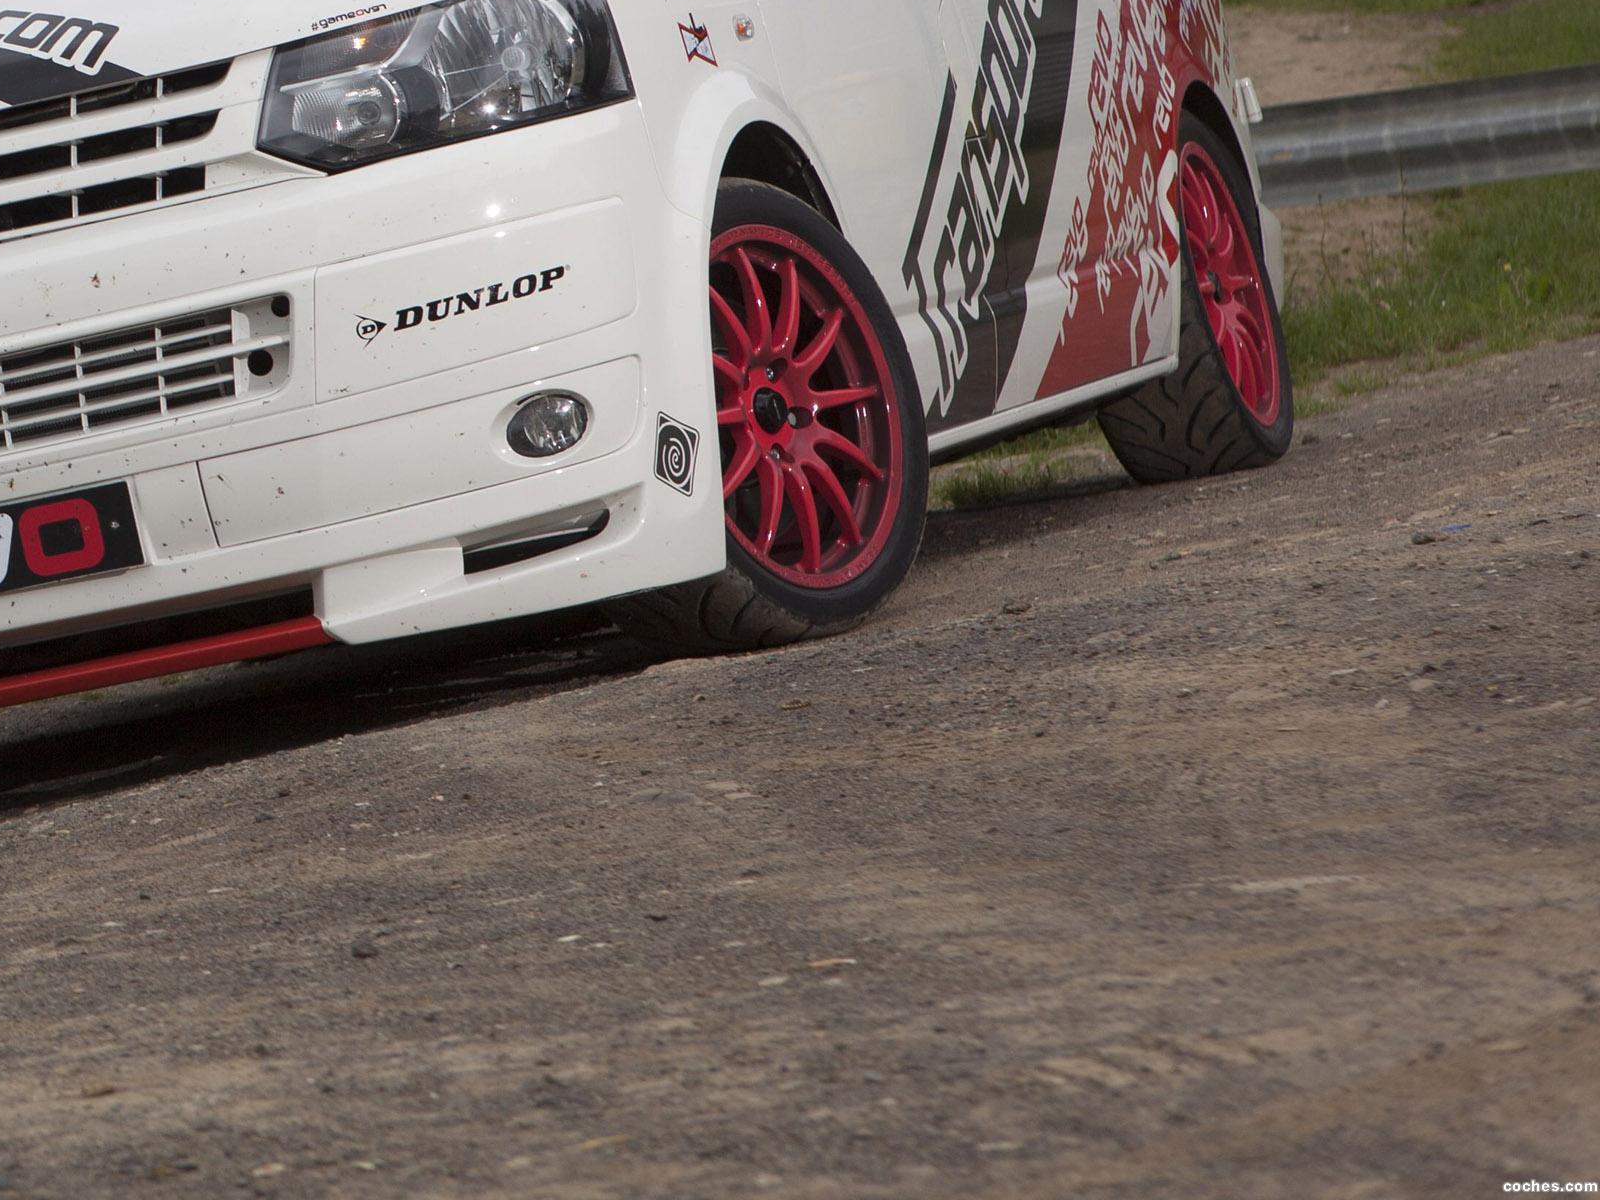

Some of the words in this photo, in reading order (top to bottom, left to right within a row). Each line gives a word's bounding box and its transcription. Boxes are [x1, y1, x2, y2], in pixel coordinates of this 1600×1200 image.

[1088, 8, 1112, 123] revo
[1153, 62, 1176, 150] revo
[1057, 196, 1083, 289] revo
[393, 265, 565, 332] DUNLOP
